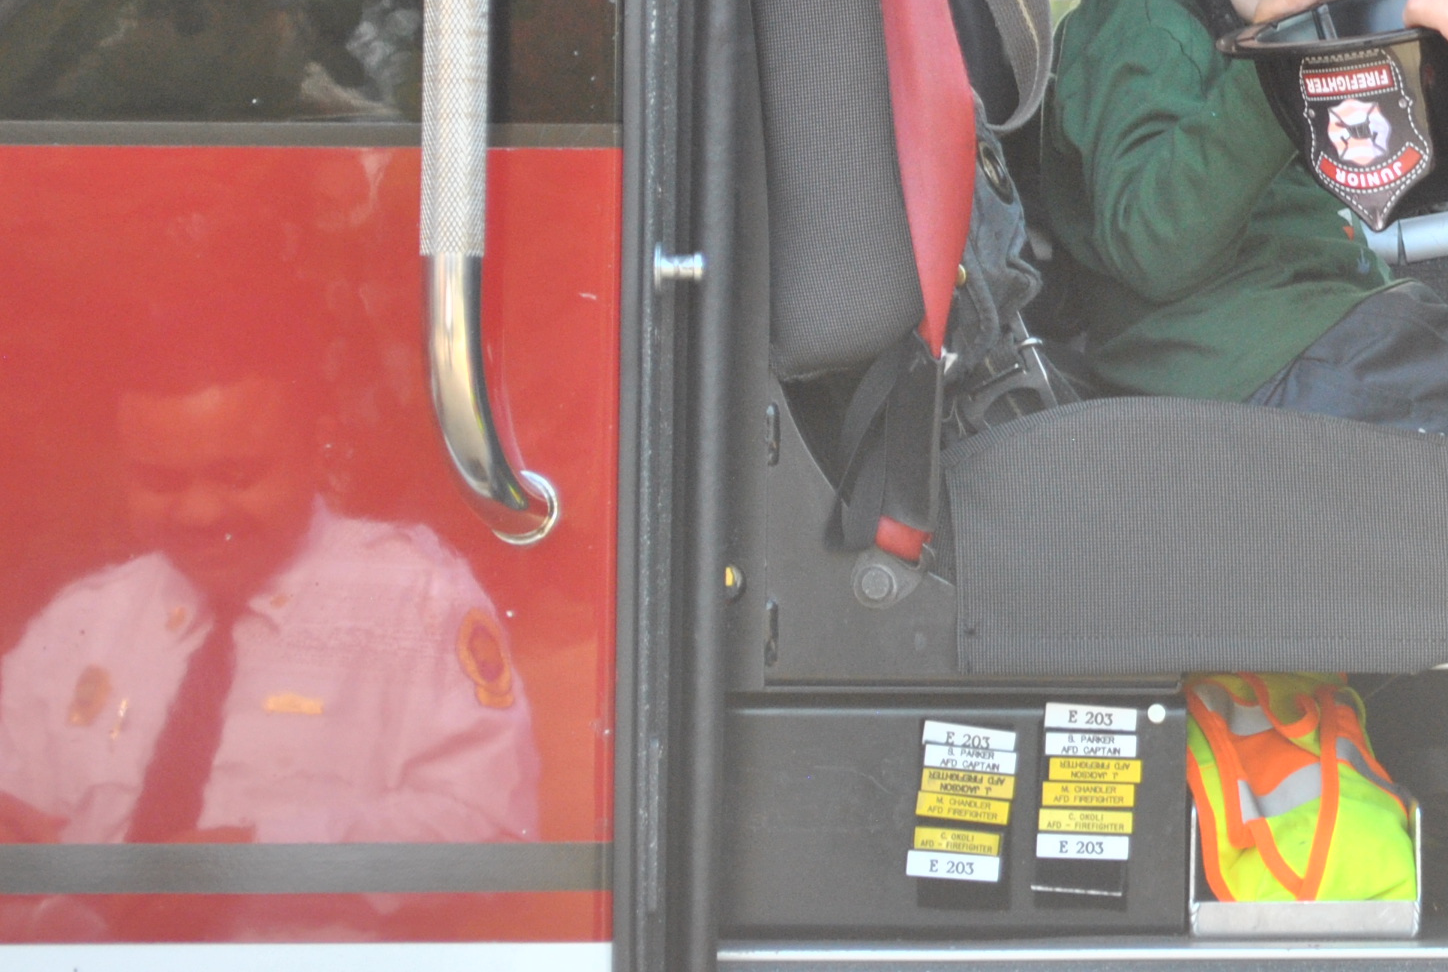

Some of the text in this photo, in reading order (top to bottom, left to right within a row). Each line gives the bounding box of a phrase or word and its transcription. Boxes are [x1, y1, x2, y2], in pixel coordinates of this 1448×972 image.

[1305, 68, 1390, 95] FIREFIGHTER
[1335, 161, 1403, 187] JUNIOR
[1068, 710, 1113, 726] E 203
[945, 731, 990, 749] E 203
[1080, 734, 1115, 744] PARKER
[960, 748, 995, 760] PARKER
[1061, 745, 1121, 756] AFD CAPTAIN
[940, 758, 1000, 771] AFD CAPTAIN
[1060, 759, 1131, 771] AFD FIREFIGHTER
[928, 770, 1006, 786] AFD FIREFIGHTER
[1074, 785, 1117, 794] CHANDLER
[949, 797, 991, 810] CHANDLER
[1053, 794, 1124, 804] AFD FIREFIGHTER
[927, 804, 998, 820] AFD FIREFIGHTER
[1046, 820, 1062, 829] AFD
[1074, 821, 1125, 831] FIREFIGHTER
[920, 839, 934, 847] AFD
[945, 841, 993, 853] FIREFIGHTER
[1059, 840, 1104, 855] E 203
[929, 859, 974, 875] E 203
